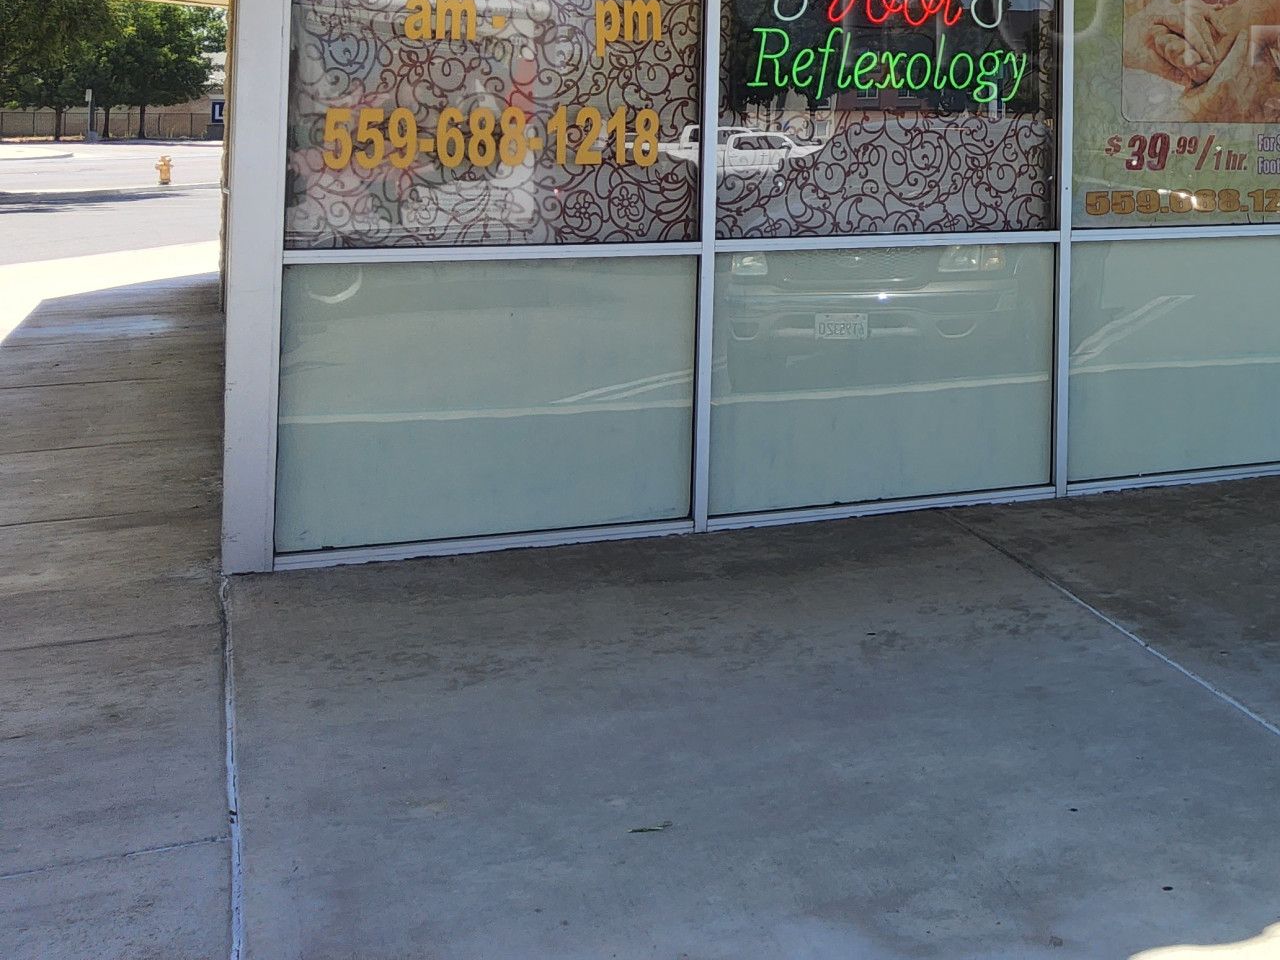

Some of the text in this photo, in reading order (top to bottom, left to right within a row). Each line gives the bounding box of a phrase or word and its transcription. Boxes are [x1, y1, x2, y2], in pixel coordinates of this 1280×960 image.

[747, 27, 1028, 104] Reflexology
[323, 104, 660, 169] 559-688-1218
[1257, 133, 1275, 152] For
[1257, 156, 1280, 175] Foot
